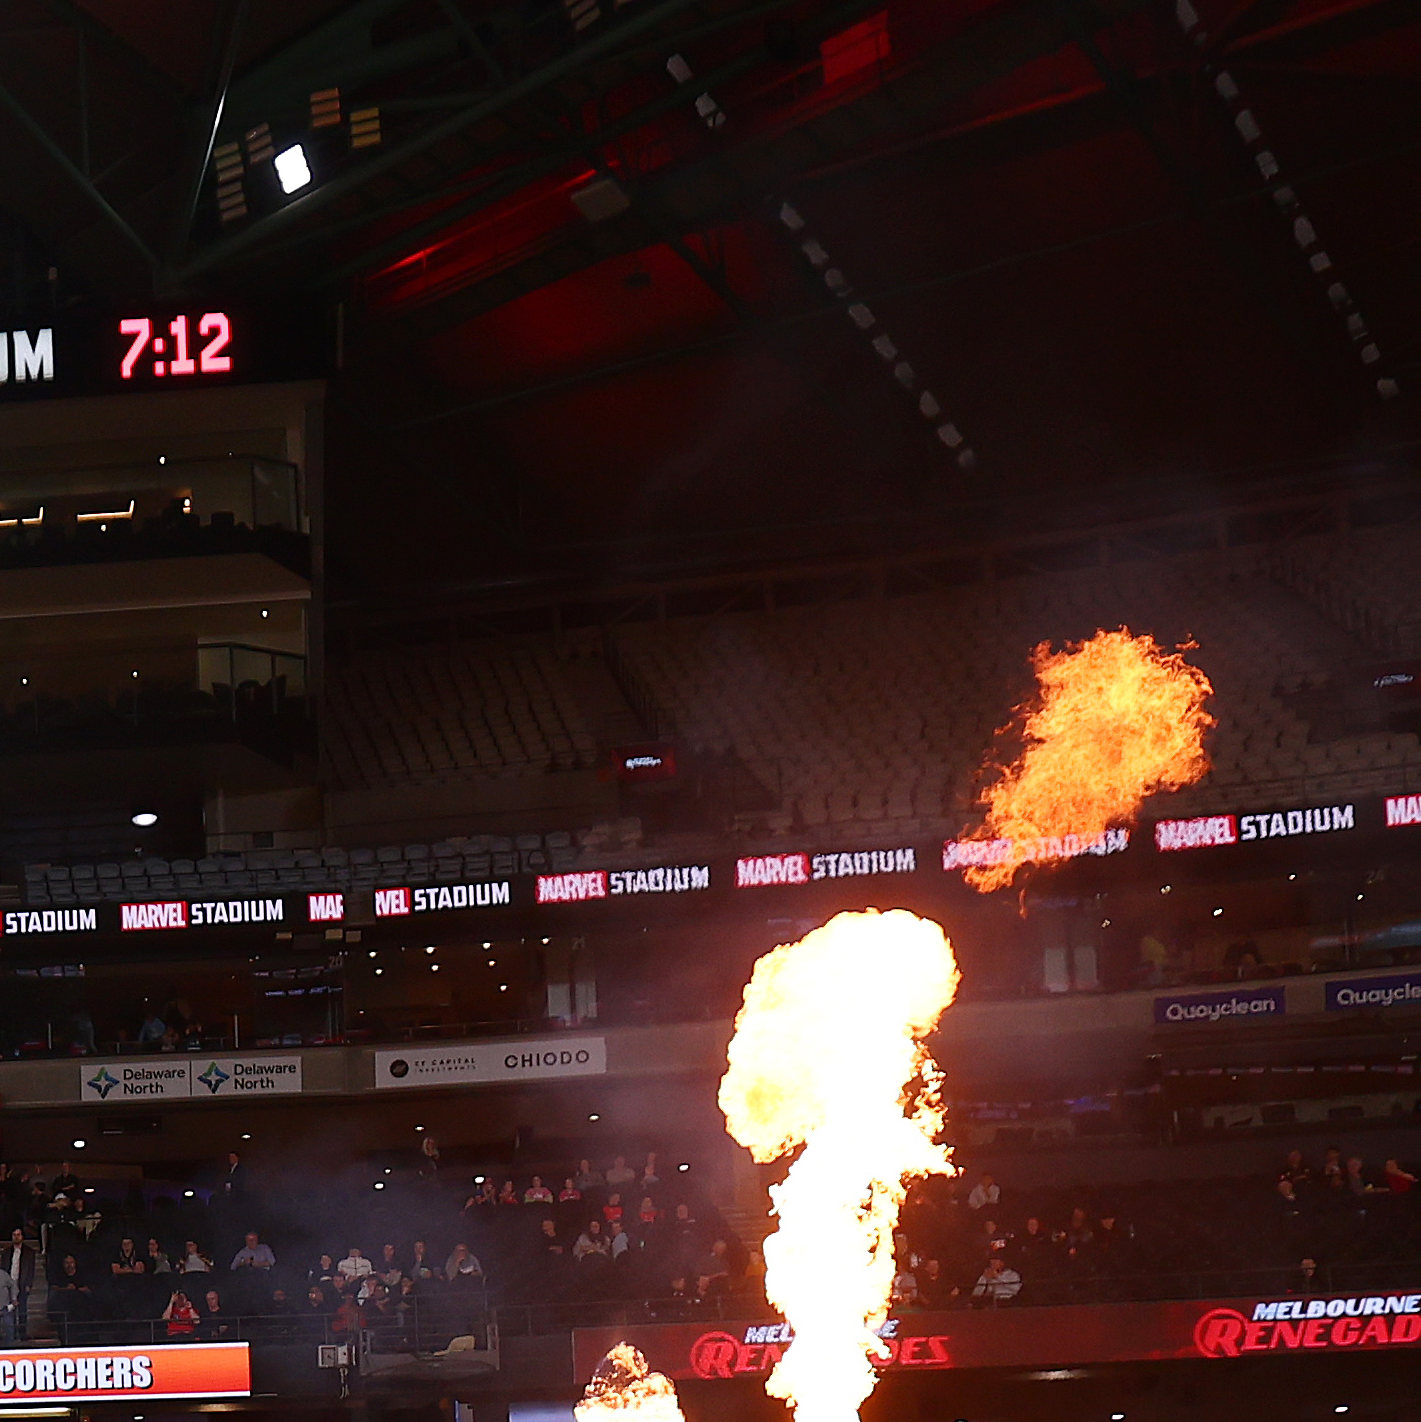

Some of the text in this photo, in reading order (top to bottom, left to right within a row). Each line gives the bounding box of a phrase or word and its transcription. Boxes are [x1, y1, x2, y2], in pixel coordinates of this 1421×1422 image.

[118, 312, 231, 379] 7:12
[1155, 815, 1236, 850] MARVEL
[1240, 804, 1354, 840] STADIUM
[735, 848, 915, 889] MARVEL STADIUM
[536, 864, 709, 904] MARVEL STADIUM
[414, 885, 510, 910] STADIUM
[5, 910, 97, 933] STADIUM
[120, 899, 283, 930] MARVEL STADIUM
[1337, 981, 1421, 1006] Quaycle
[234, 1062, 297, 1077] Delaware
[504, 1049, 590, 1068] CHIODO
[122, 1067, 186, 1081] Delaware
[234, 1077, 275, 1090] North
[122, 1082, 164, 1095] North
[1252, 1295, 1421, 1322] MELBOURNE
[1194, 1307, 1421, 1358] RENEGAD
